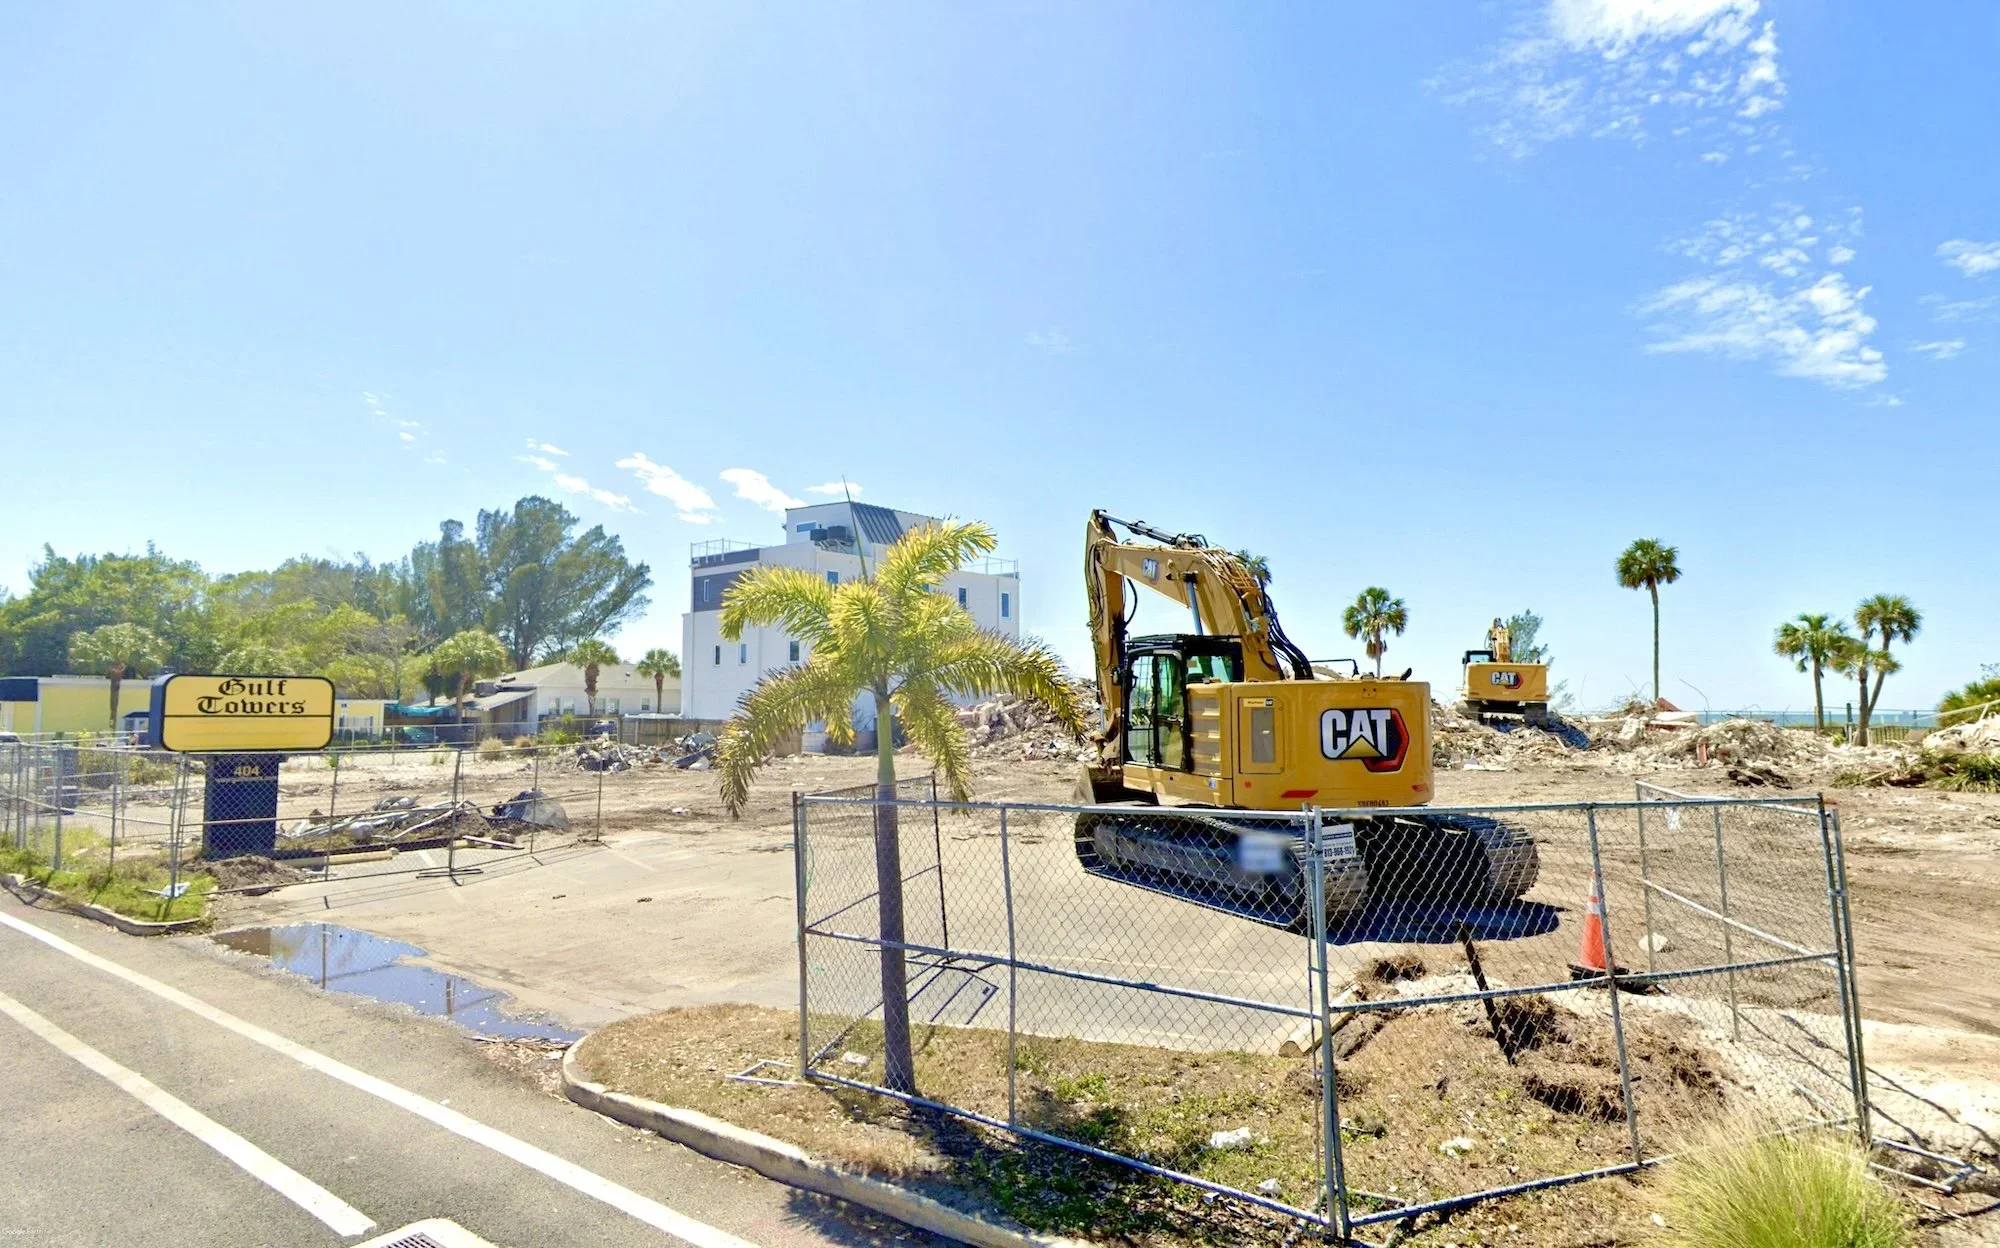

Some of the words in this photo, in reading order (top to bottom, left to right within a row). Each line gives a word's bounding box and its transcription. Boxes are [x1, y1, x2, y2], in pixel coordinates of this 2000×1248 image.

[218, 678, 288, 696] Gulf
[1491, 671, 1517, 685] CAT
[196, 696, 306, 714] Towers
[1321, 708, 1392, 759] CAT
[233, 766, 260, 777] 404
